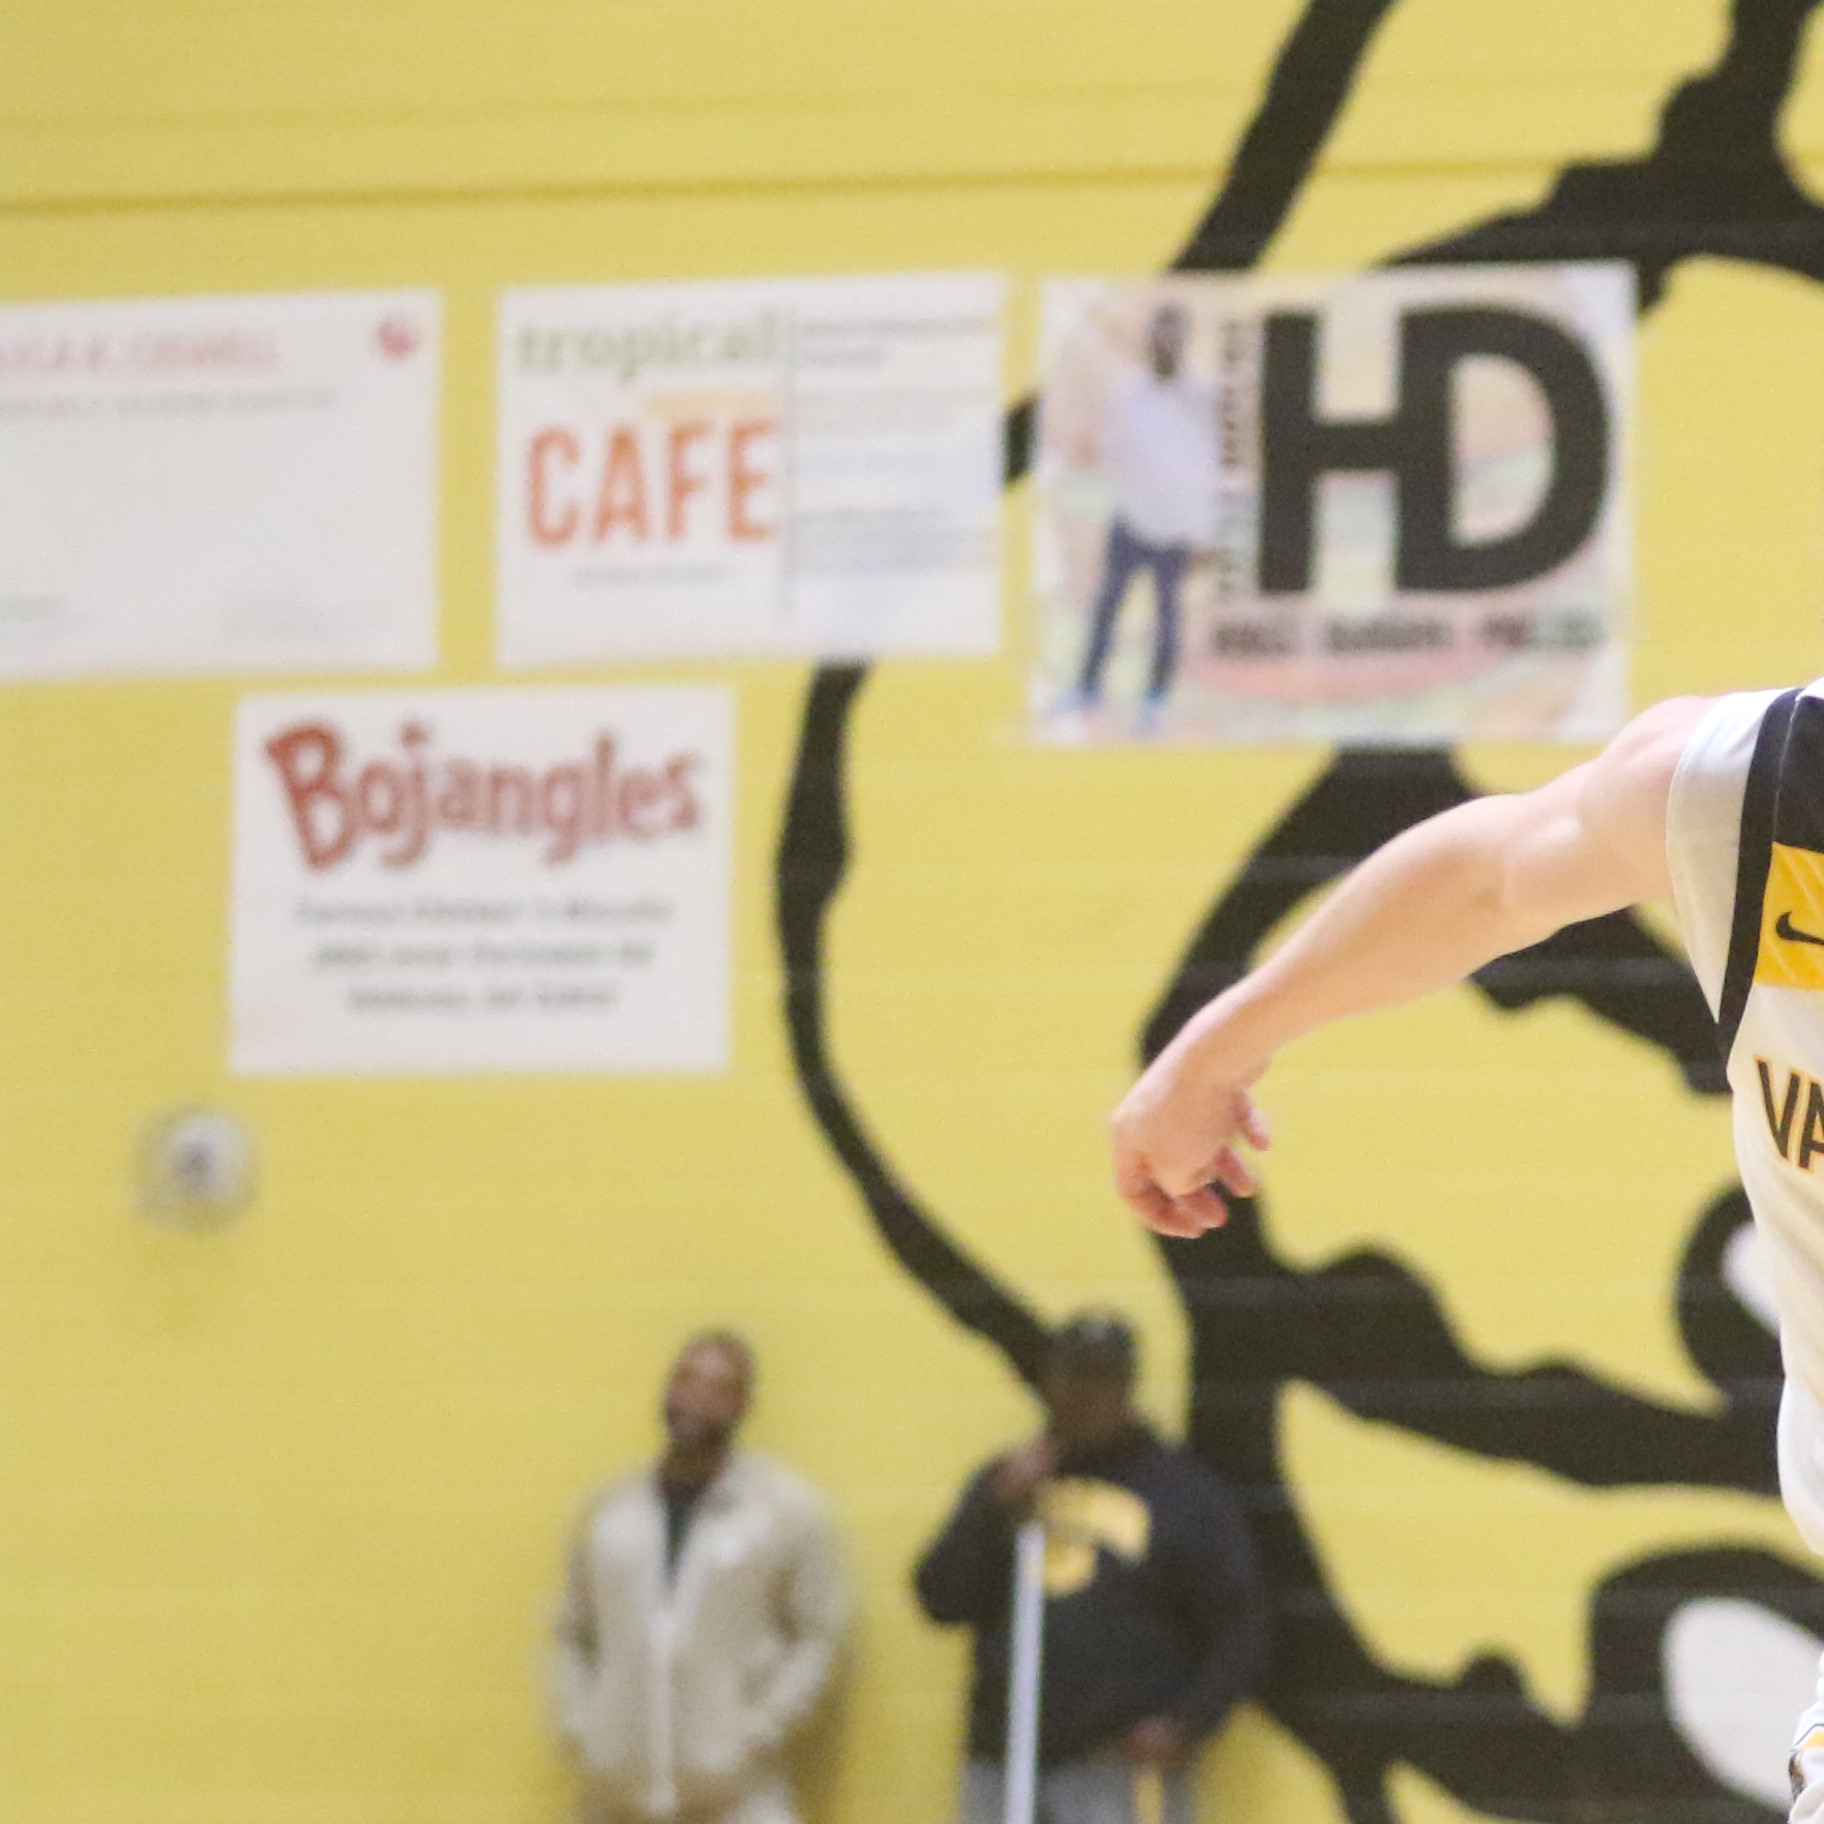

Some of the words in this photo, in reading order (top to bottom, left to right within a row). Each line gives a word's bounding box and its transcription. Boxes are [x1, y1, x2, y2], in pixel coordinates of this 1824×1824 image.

[517, 311, 779, 382] tropical
[523, 416, 782, 548] CAFE
[1258, 301, 1610, 594] HD
[264, 716, 704, 873] Bojangles
